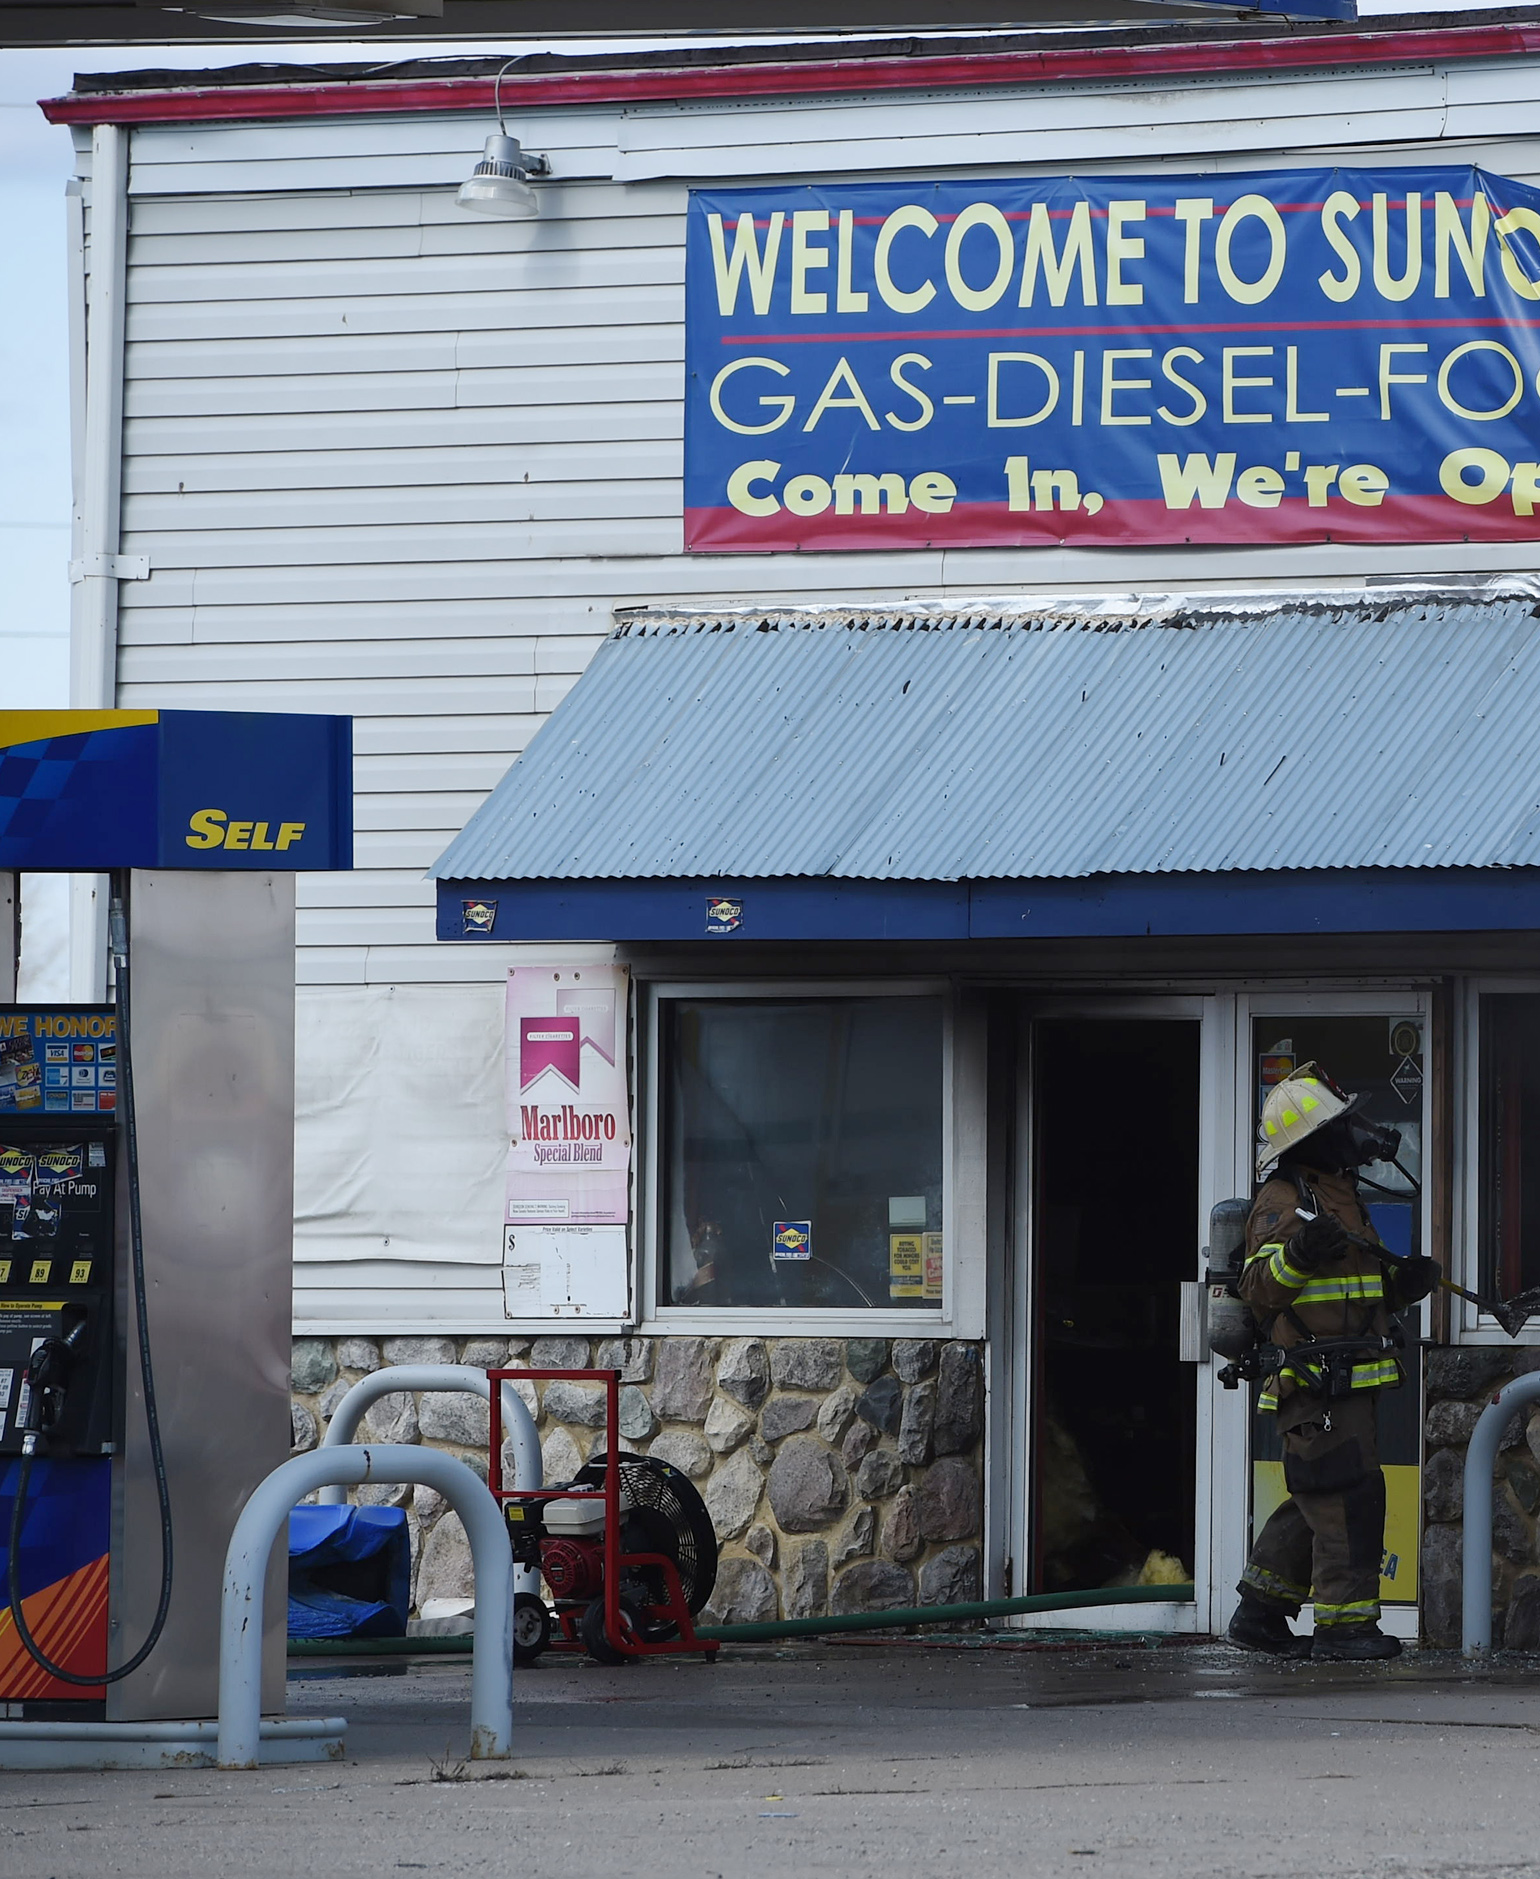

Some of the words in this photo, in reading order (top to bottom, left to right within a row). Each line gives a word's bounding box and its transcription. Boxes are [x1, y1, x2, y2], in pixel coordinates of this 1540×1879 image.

[707, 200, 1145, 317] WELCOME
[1174, 193, 1287, 306] TO
[727, 459, 957, 517] Come
[1156, 451, 1389, 509] We're
[465, 909, 494, 919] SUNOCO
[710, 906, 740, 917] SUNOCO
[1394, 1077, 1422, 1085] WARNING
[520, 1104, 616, 1141] Marlboro
[533, 1143, 572, 1166] Special
[572, 1142, 603, 1163] Blend
[0, 1156, 31, 1167] UNOCO
[40, 1156, 79, 1166] SUNOCO
[33, 1180, 51, 1198] Pay
[53, 1182, 66, 1195] At
[68, 1180, 97, 1198] Pump
[777, 1234, 806, 1243] SUNOCO
[35, 1268, 45, 1278] 89
[75, 1268, 85, 1278] 93
